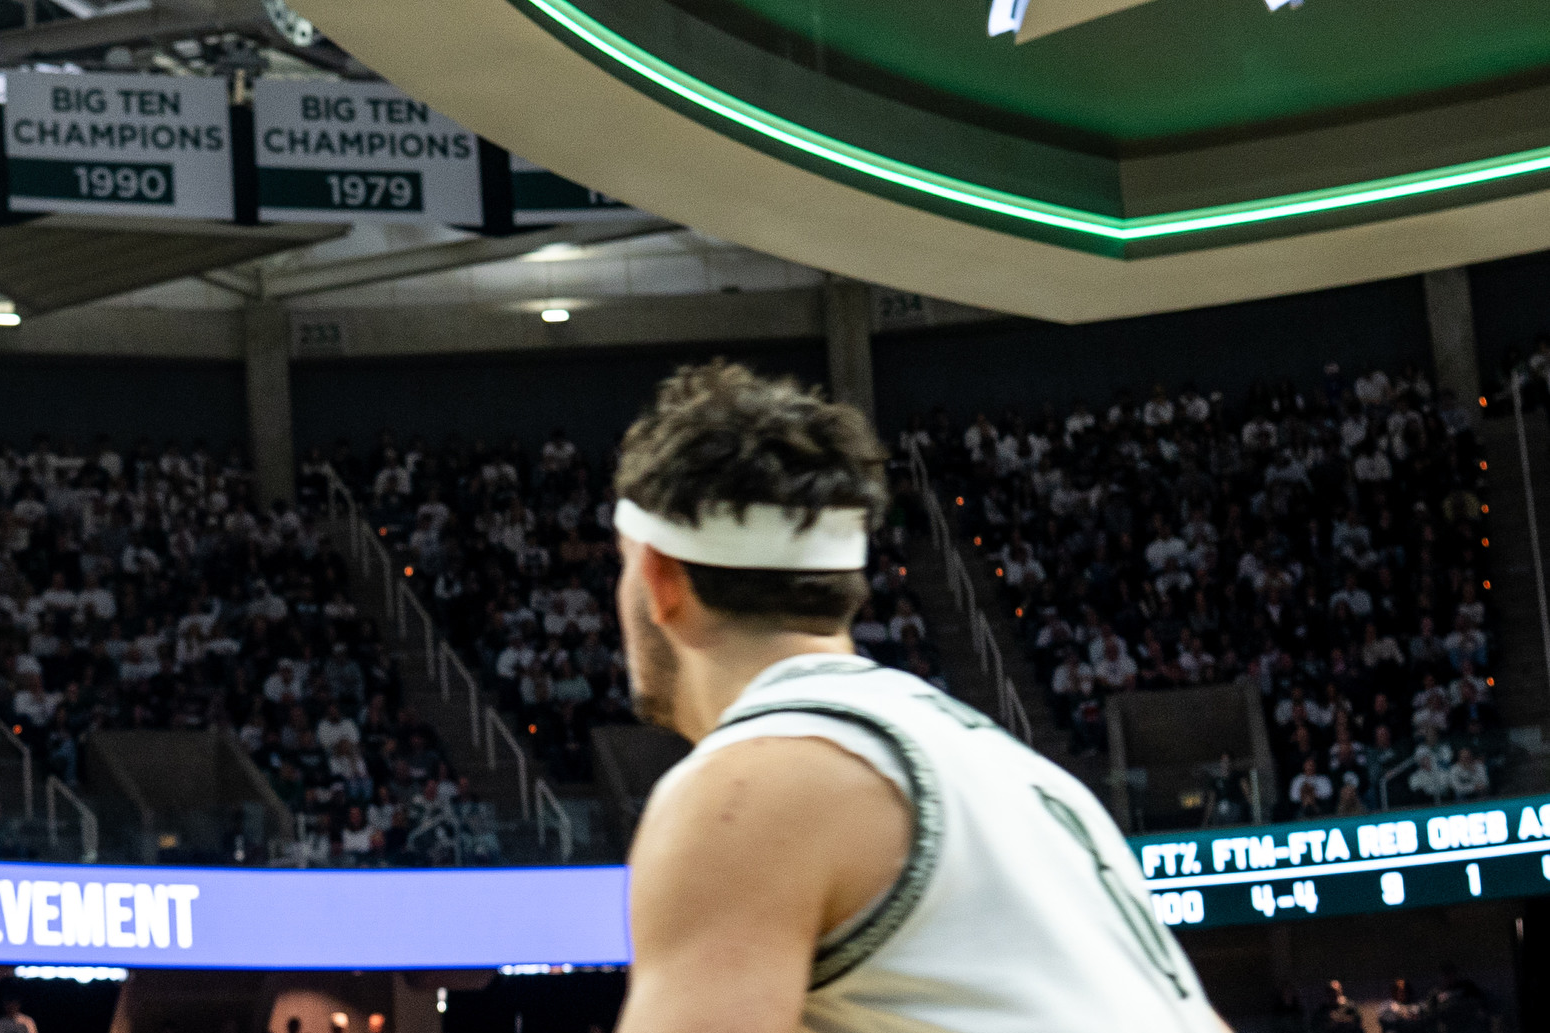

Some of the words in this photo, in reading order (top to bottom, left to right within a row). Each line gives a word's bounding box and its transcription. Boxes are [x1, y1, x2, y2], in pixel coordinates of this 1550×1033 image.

[52, 86, 107, 115] BIG
[118, 89, 181, 117] TEN
[302, 96, 357, 124] BIG
[365, 96, 429, 125] TEN
[13, 117, 224, 152] CHAMPIONS
[263, 128, 474, 160] CHAMPIONS
[74, 165, 168, 200] 1990
[326, 173, 414, 208] 1979
[1141, 841, 1202, 878] FT%
[1211, 828, 1351, 872] FTM-FTA
[1465, 862, 1482, 896] 1
